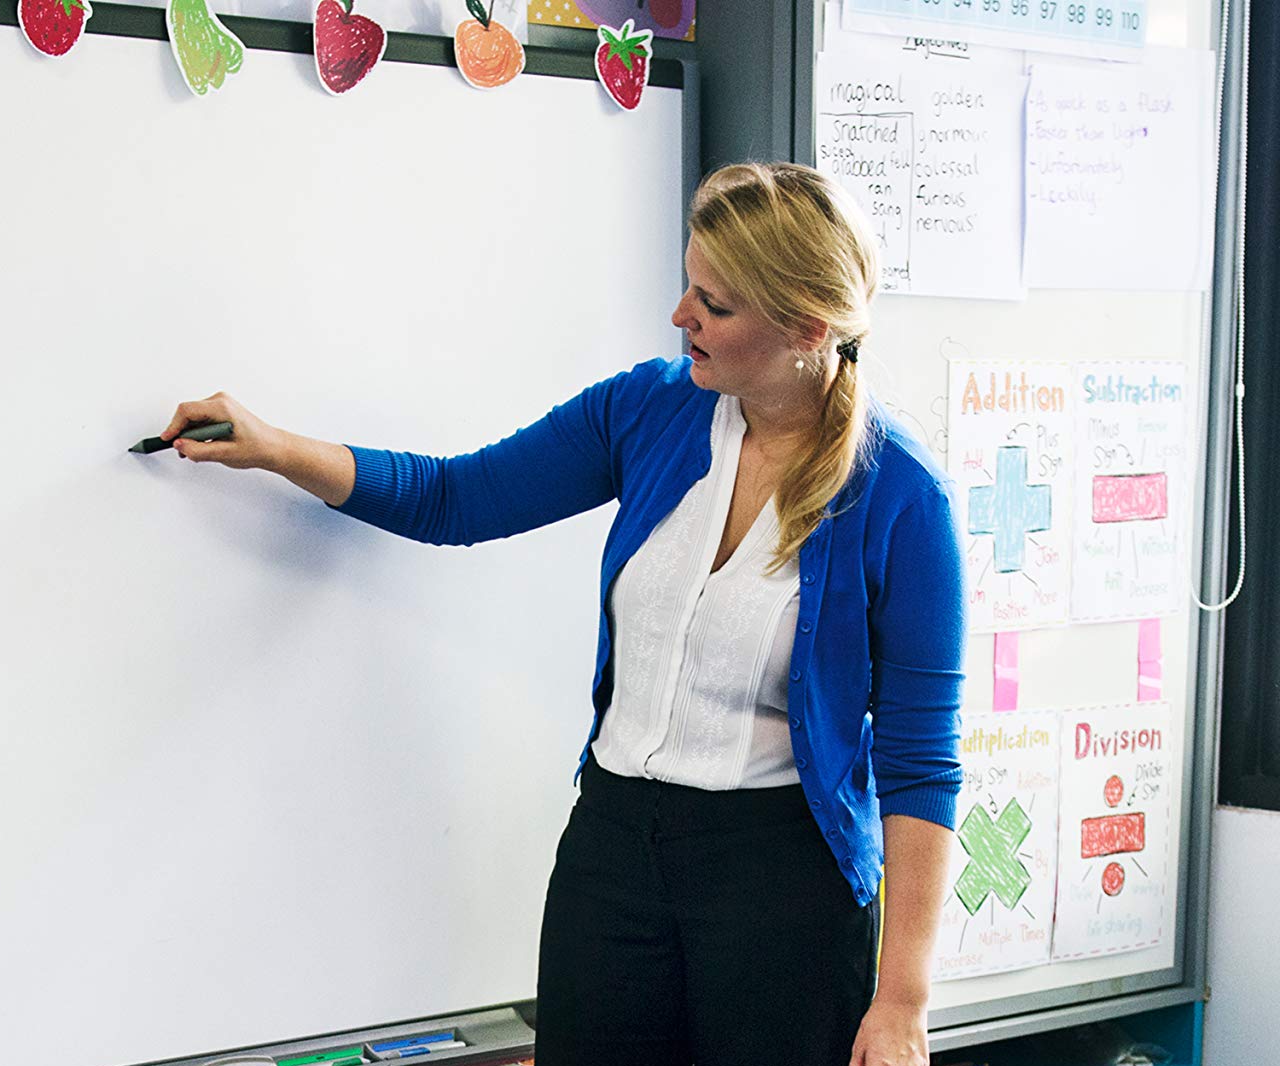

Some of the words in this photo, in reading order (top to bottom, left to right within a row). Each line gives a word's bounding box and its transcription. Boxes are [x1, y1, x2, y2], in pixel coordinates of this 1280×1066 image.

[1040, 0, 1057, 20] 97
[1067, 4, 1086, 24] 98
[1096, 7, 1113, 26] 99
[830, 74, 904, 112] magical
[961, 371, 1065, 415] Addition
[1082, 374, 1182, 405] Subtraction
[961, 724, 1050, 757] ultiplication
[1075, 722, 1162, 760] Division
